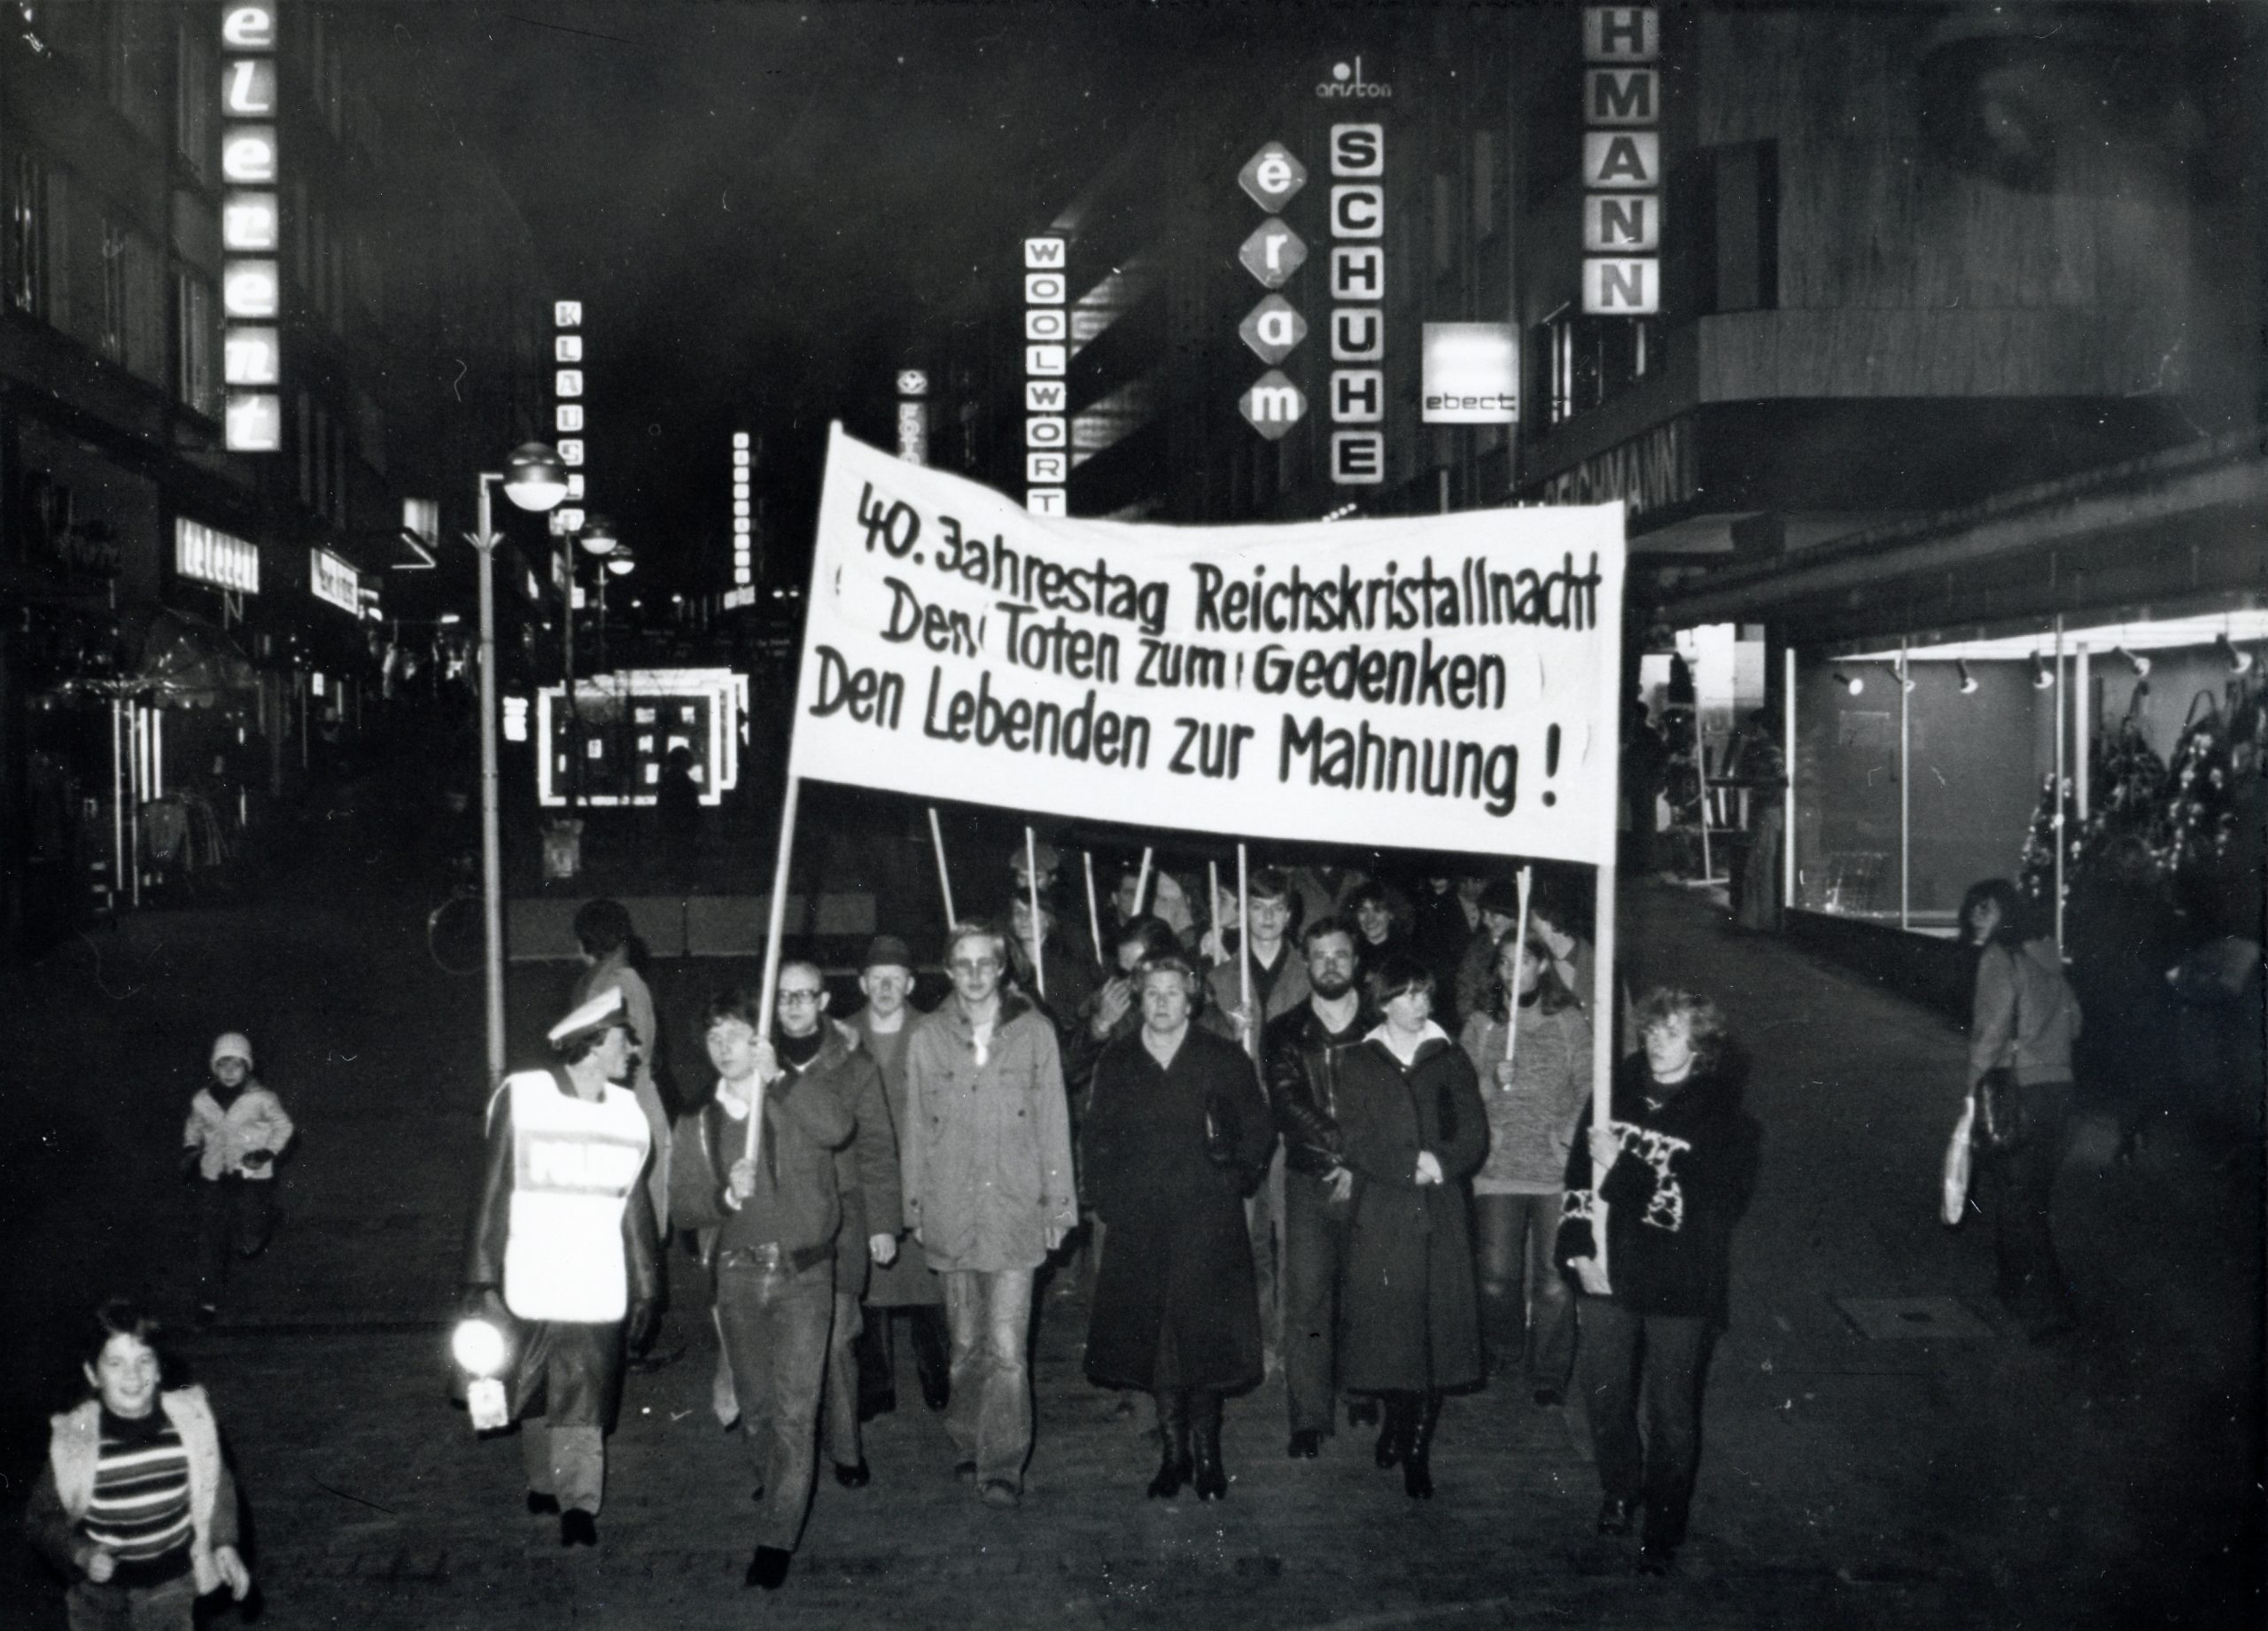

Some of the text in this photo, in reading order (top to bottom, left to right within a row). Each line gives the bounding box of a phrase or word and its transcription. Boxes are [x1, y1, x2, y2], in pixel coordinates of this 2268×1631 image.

[1316, 55, 1392, 97] ariston
[1596, 9, 1651, 308] HMANN
[1029, 244, 1061, 513] WOOLWORT
[1336, 129, 1379, 477] SCHUHE
[858, 481, 1603, 636] 40. Jahrestag Reichskristallnacht
[880, 576, 1506, 710] Den Toten zum Gedenken
[809, 645, 905, 731] Den
[923, 664, 1151, 771] Lebenden
[1168, 717, 1255, 781] zur
[1278, 712, 1519, 817] Mahnung
